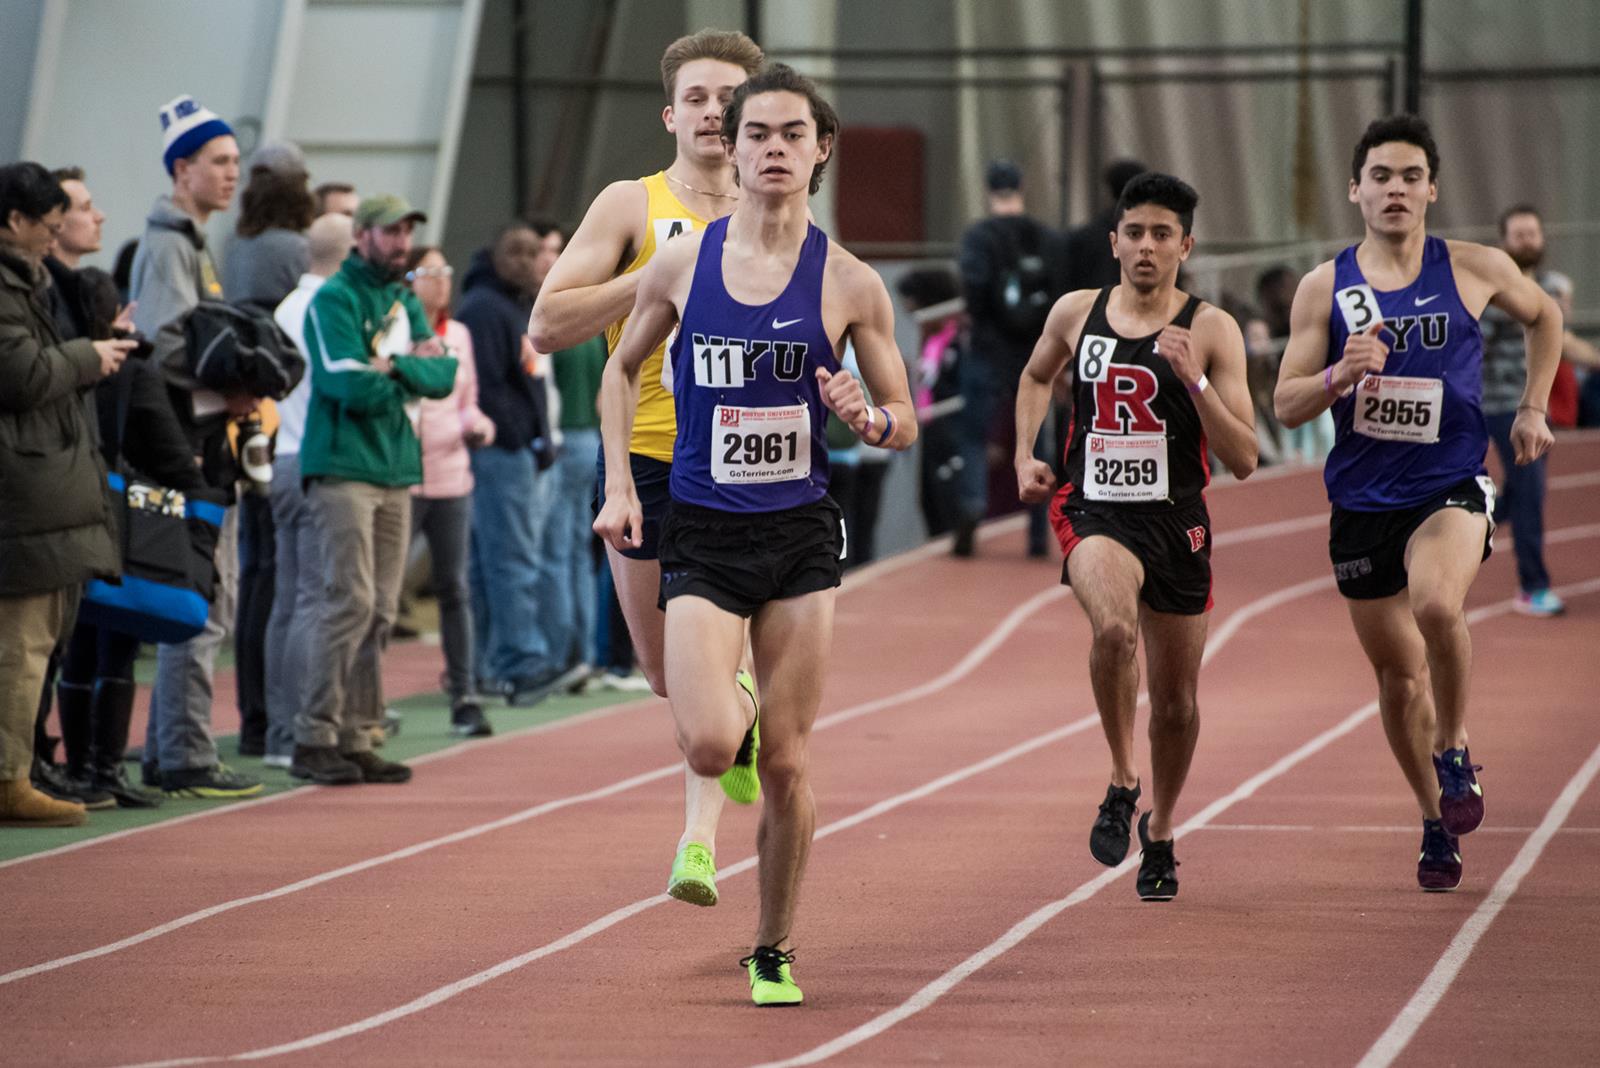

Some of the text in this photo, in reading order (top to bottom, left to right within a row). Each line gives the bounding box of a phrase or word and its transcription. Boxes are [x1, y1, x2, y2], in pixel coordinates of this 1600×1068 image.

[1345, 289, 1373, 327] 3
[1384, 312, 1449, 352] YU
[692, 333, 808, 382] YU
[700, 348, 732, 384] 11
[1084, 339, 1107, 379] 8
[1092, 363, 1166, 434] R
[1364, 397, 1432, 426] 2955
[720, 408, 740, 425] BU
[723, 432, 797, 465] 2961
[730, 467, 794, 478] GoTerriers.com
[1094, 458, 1158, 486] 3259
[1187, 525, 1206, 553] R
